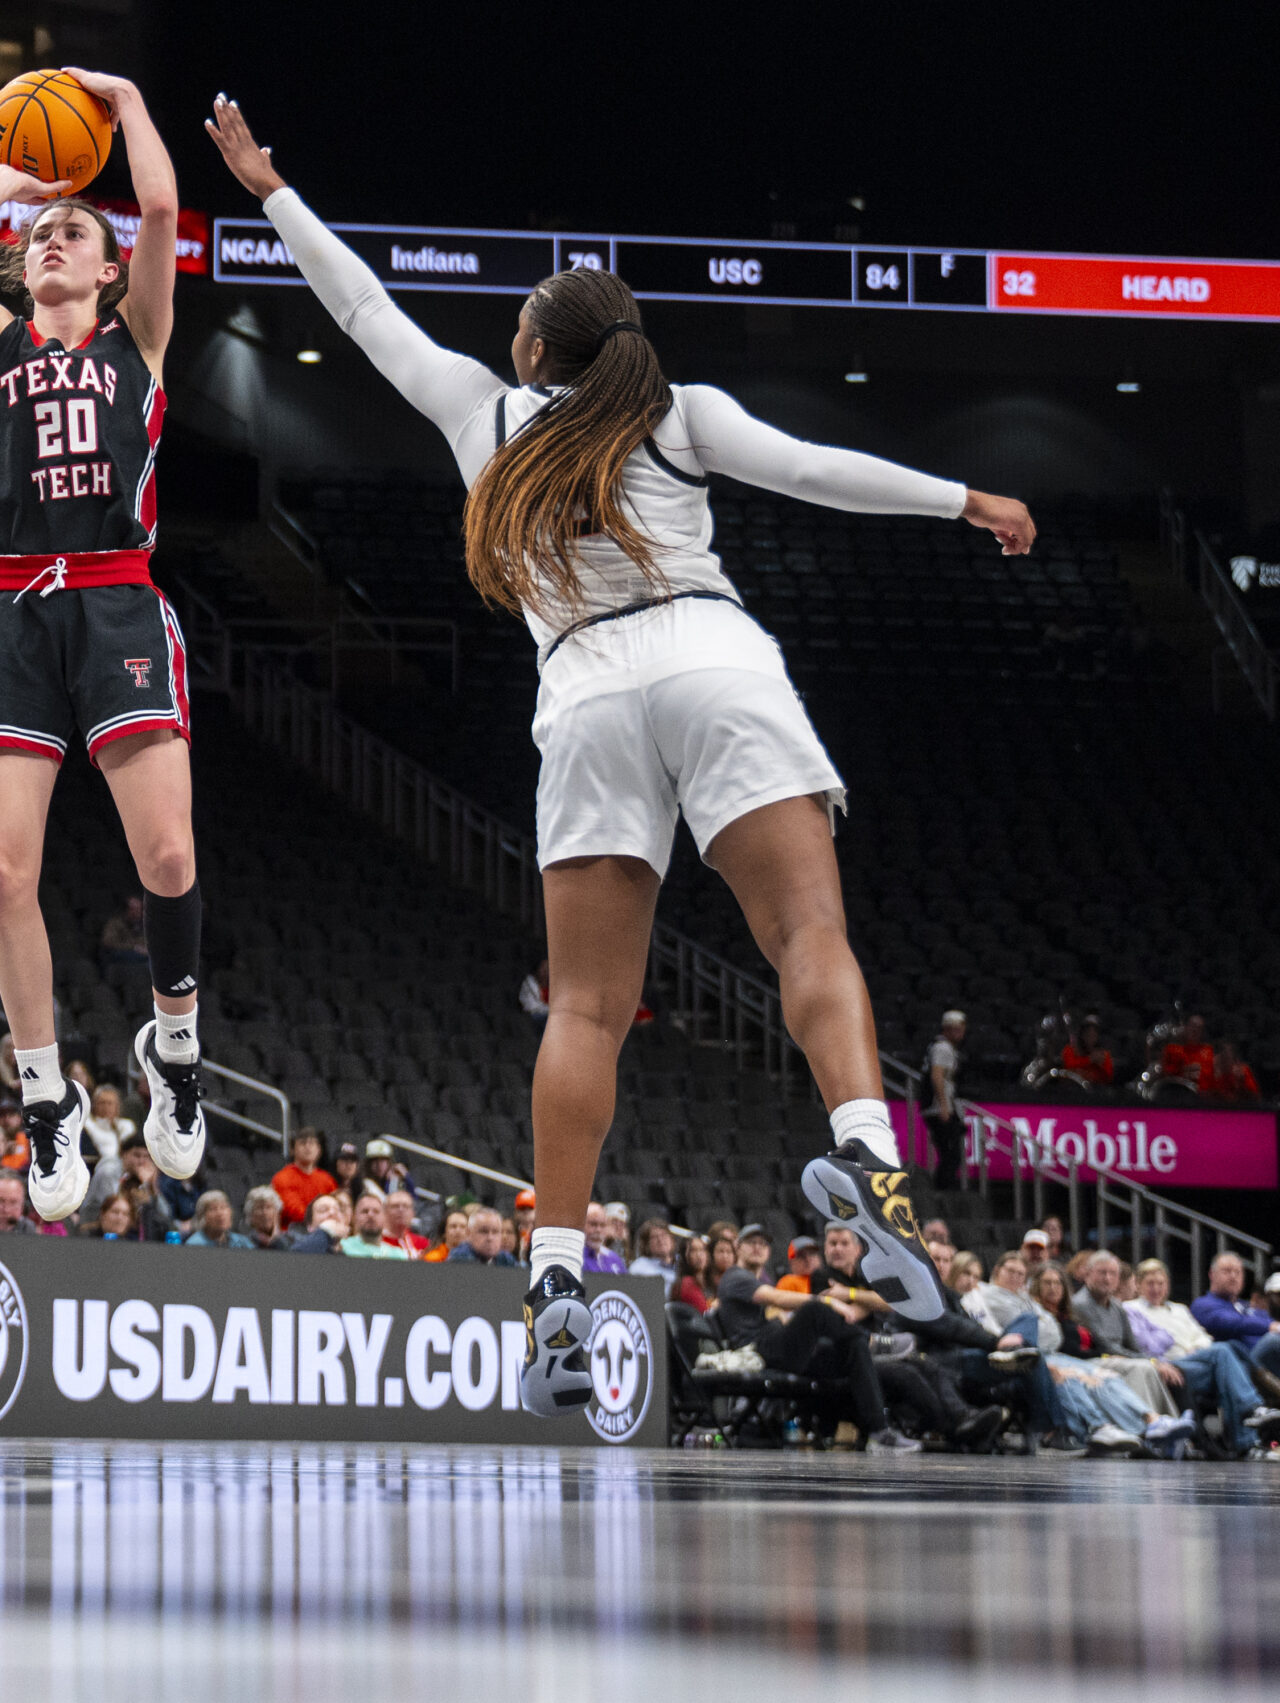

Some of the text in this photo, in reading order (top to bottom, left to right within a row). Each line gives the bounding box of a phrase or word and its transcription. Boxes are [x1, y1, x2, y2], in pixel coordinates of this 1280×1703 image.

[390, 244, 480, 275] Indiana
[708, 258, 763, 286] USC
[939, 254, 955, 278] F
[865, 263, 902, 291] 84
[1002, 271, 1036, 297] 32
[1122, 275, 1211, 303] HEARD
[0, 357, 118, 408] TEXAS
[34, 398, 98, 459] 20
[31, 462, 112, 503] TECH
[1010, 1117, 1178, 1174] Mobile
[595, 1405, 634, 1434] DAIRY
